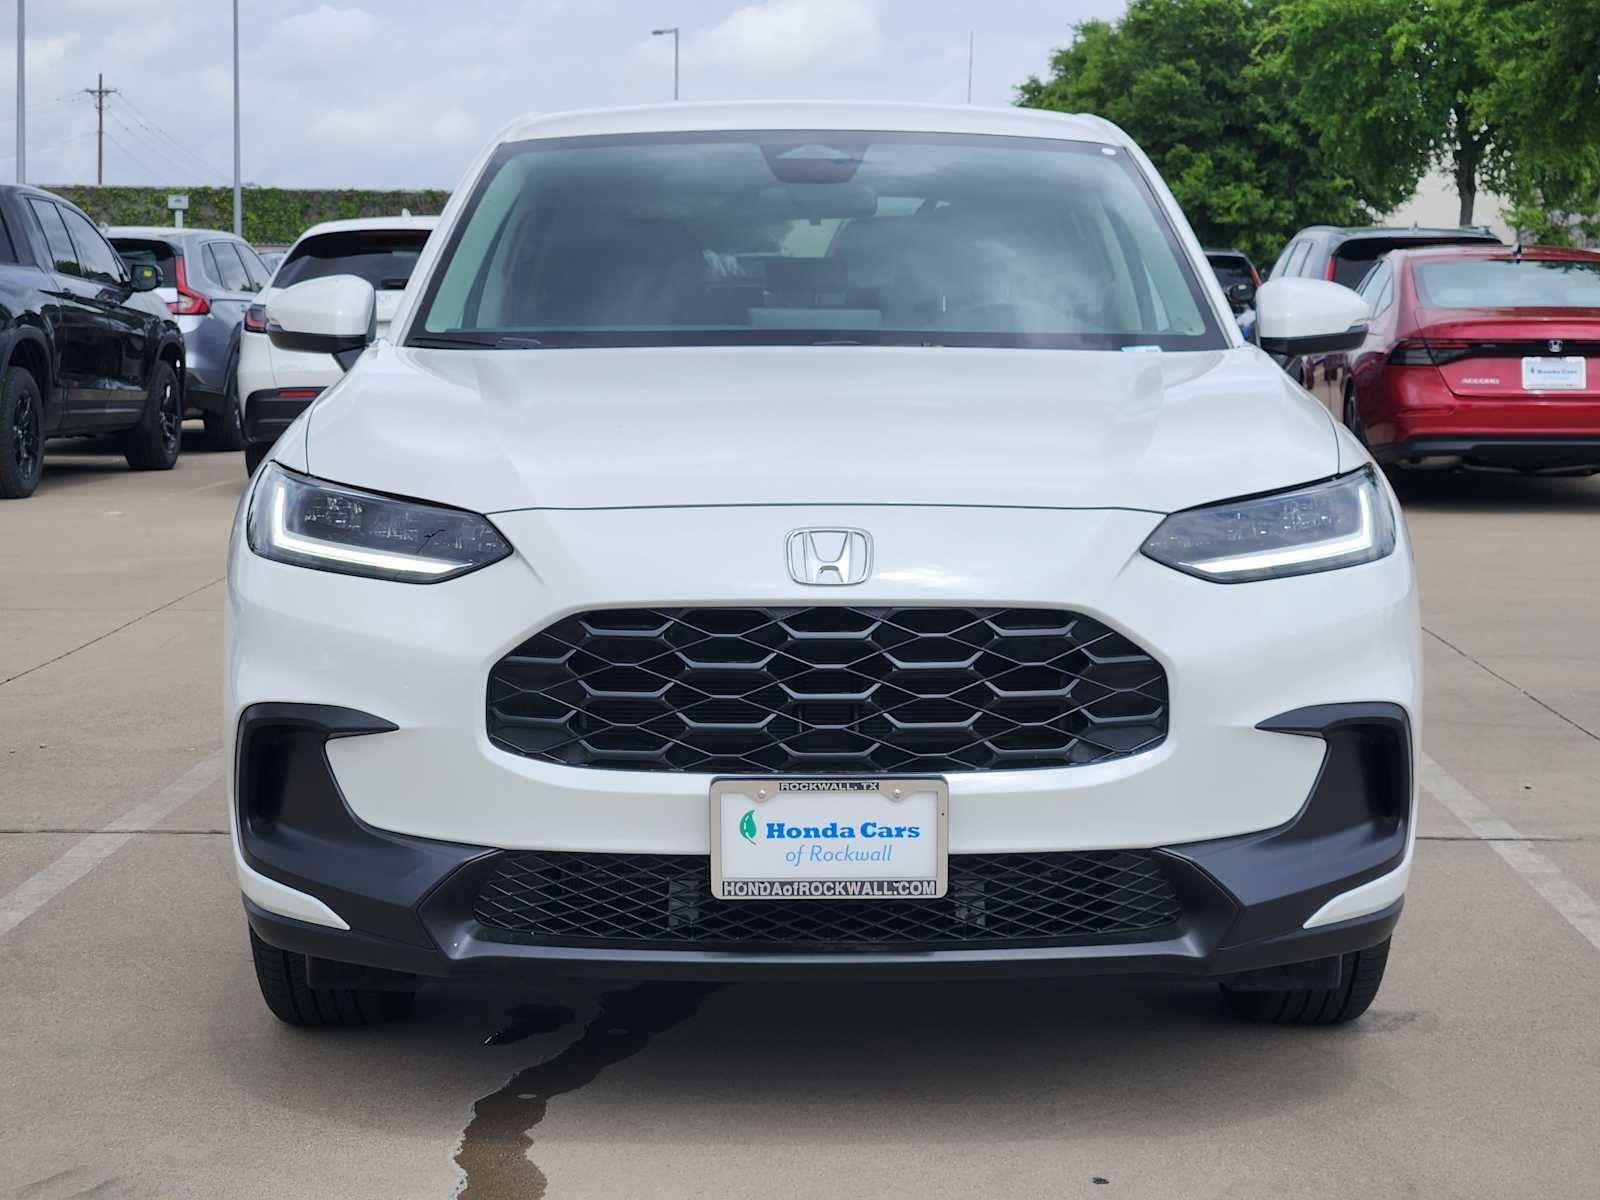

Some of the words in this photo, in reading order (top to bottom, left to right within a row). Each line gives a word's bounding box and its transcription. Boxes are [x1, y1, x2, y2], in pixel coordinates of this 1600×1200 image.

[766, 822, 856, 839] Honda
[860, 822, 921, 839] Cars
[785, 844, 805, 867] of
[809, 844, 893, 862] Rockwall
